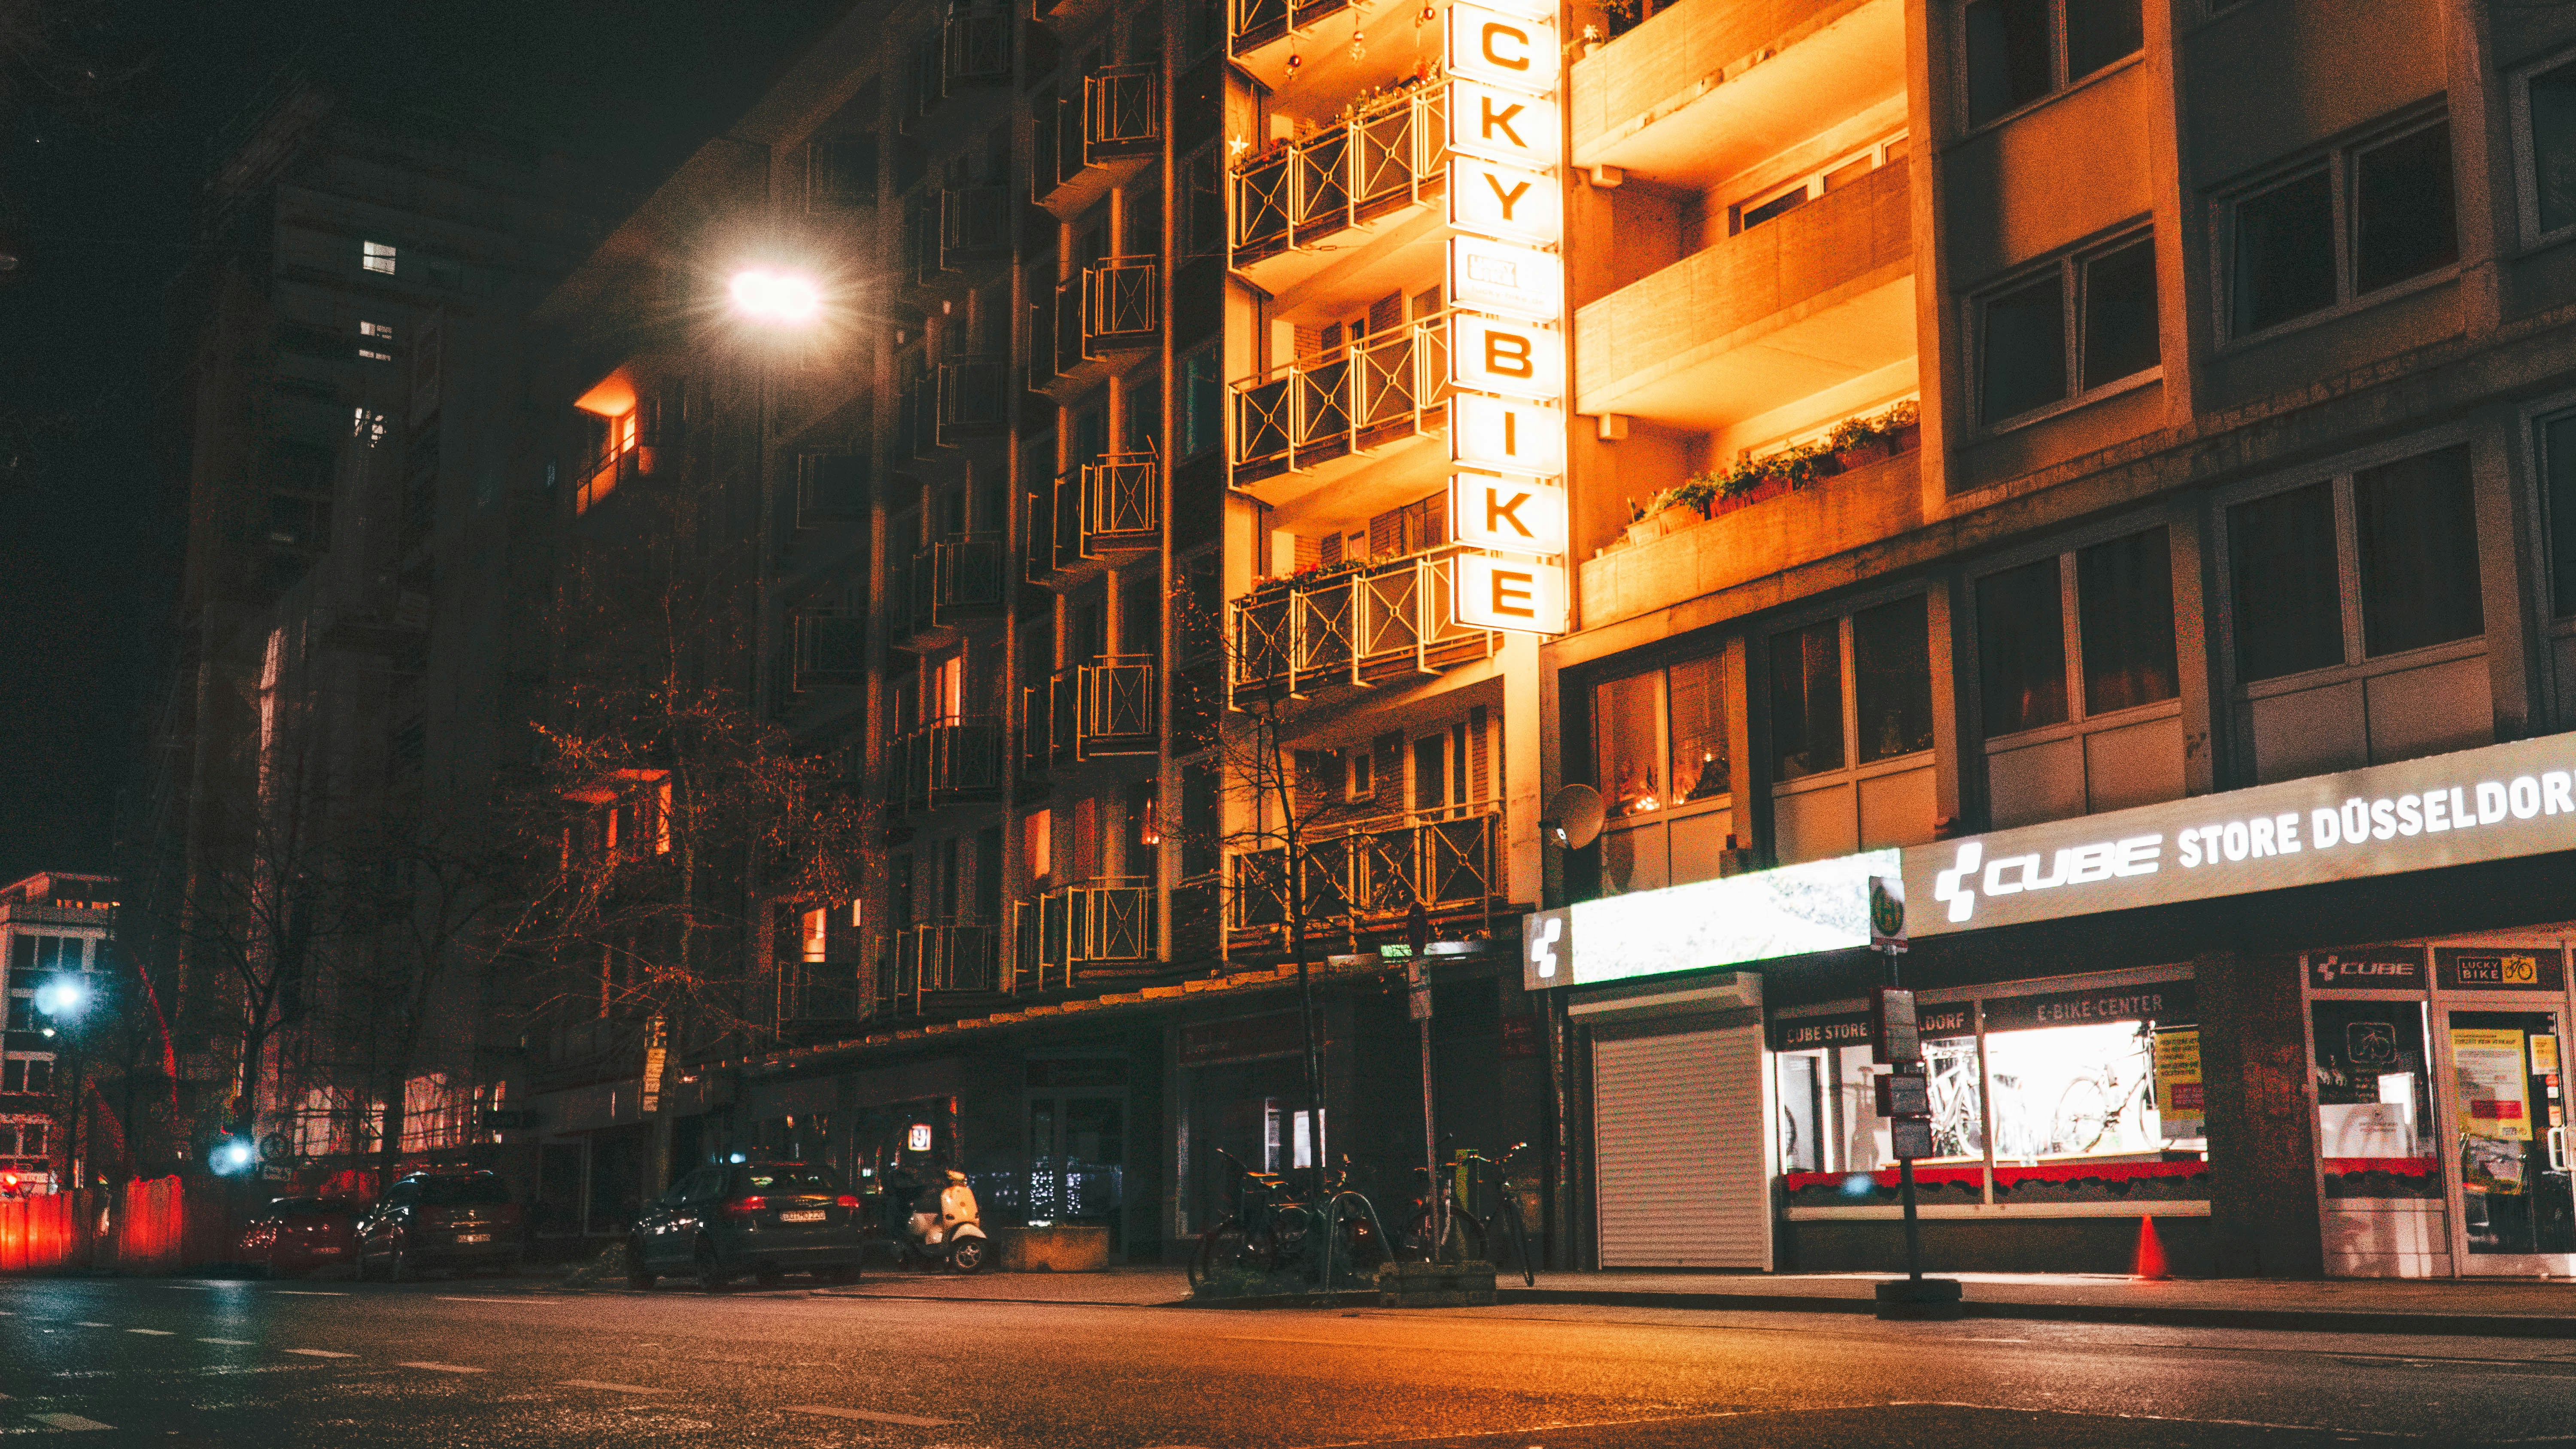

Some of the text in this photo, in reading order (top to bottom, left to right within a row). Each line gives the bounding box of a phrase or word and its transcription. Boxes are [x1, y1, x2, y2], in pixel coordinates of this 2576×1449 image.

[1484, 329, 1535, 618] BIKE
[1984, 771, 2576, 897] CUBE STORE DÜSSELDOR
[2340, 962, 2415, 975] CUBE
[2463, 970, 2499, 979] BIKE
[2099, 995, 2163, 1016] CENTER
[1787, 1026, 1821, 1043] CUBE
[1825, 1023, 1868, 1039] STORE
